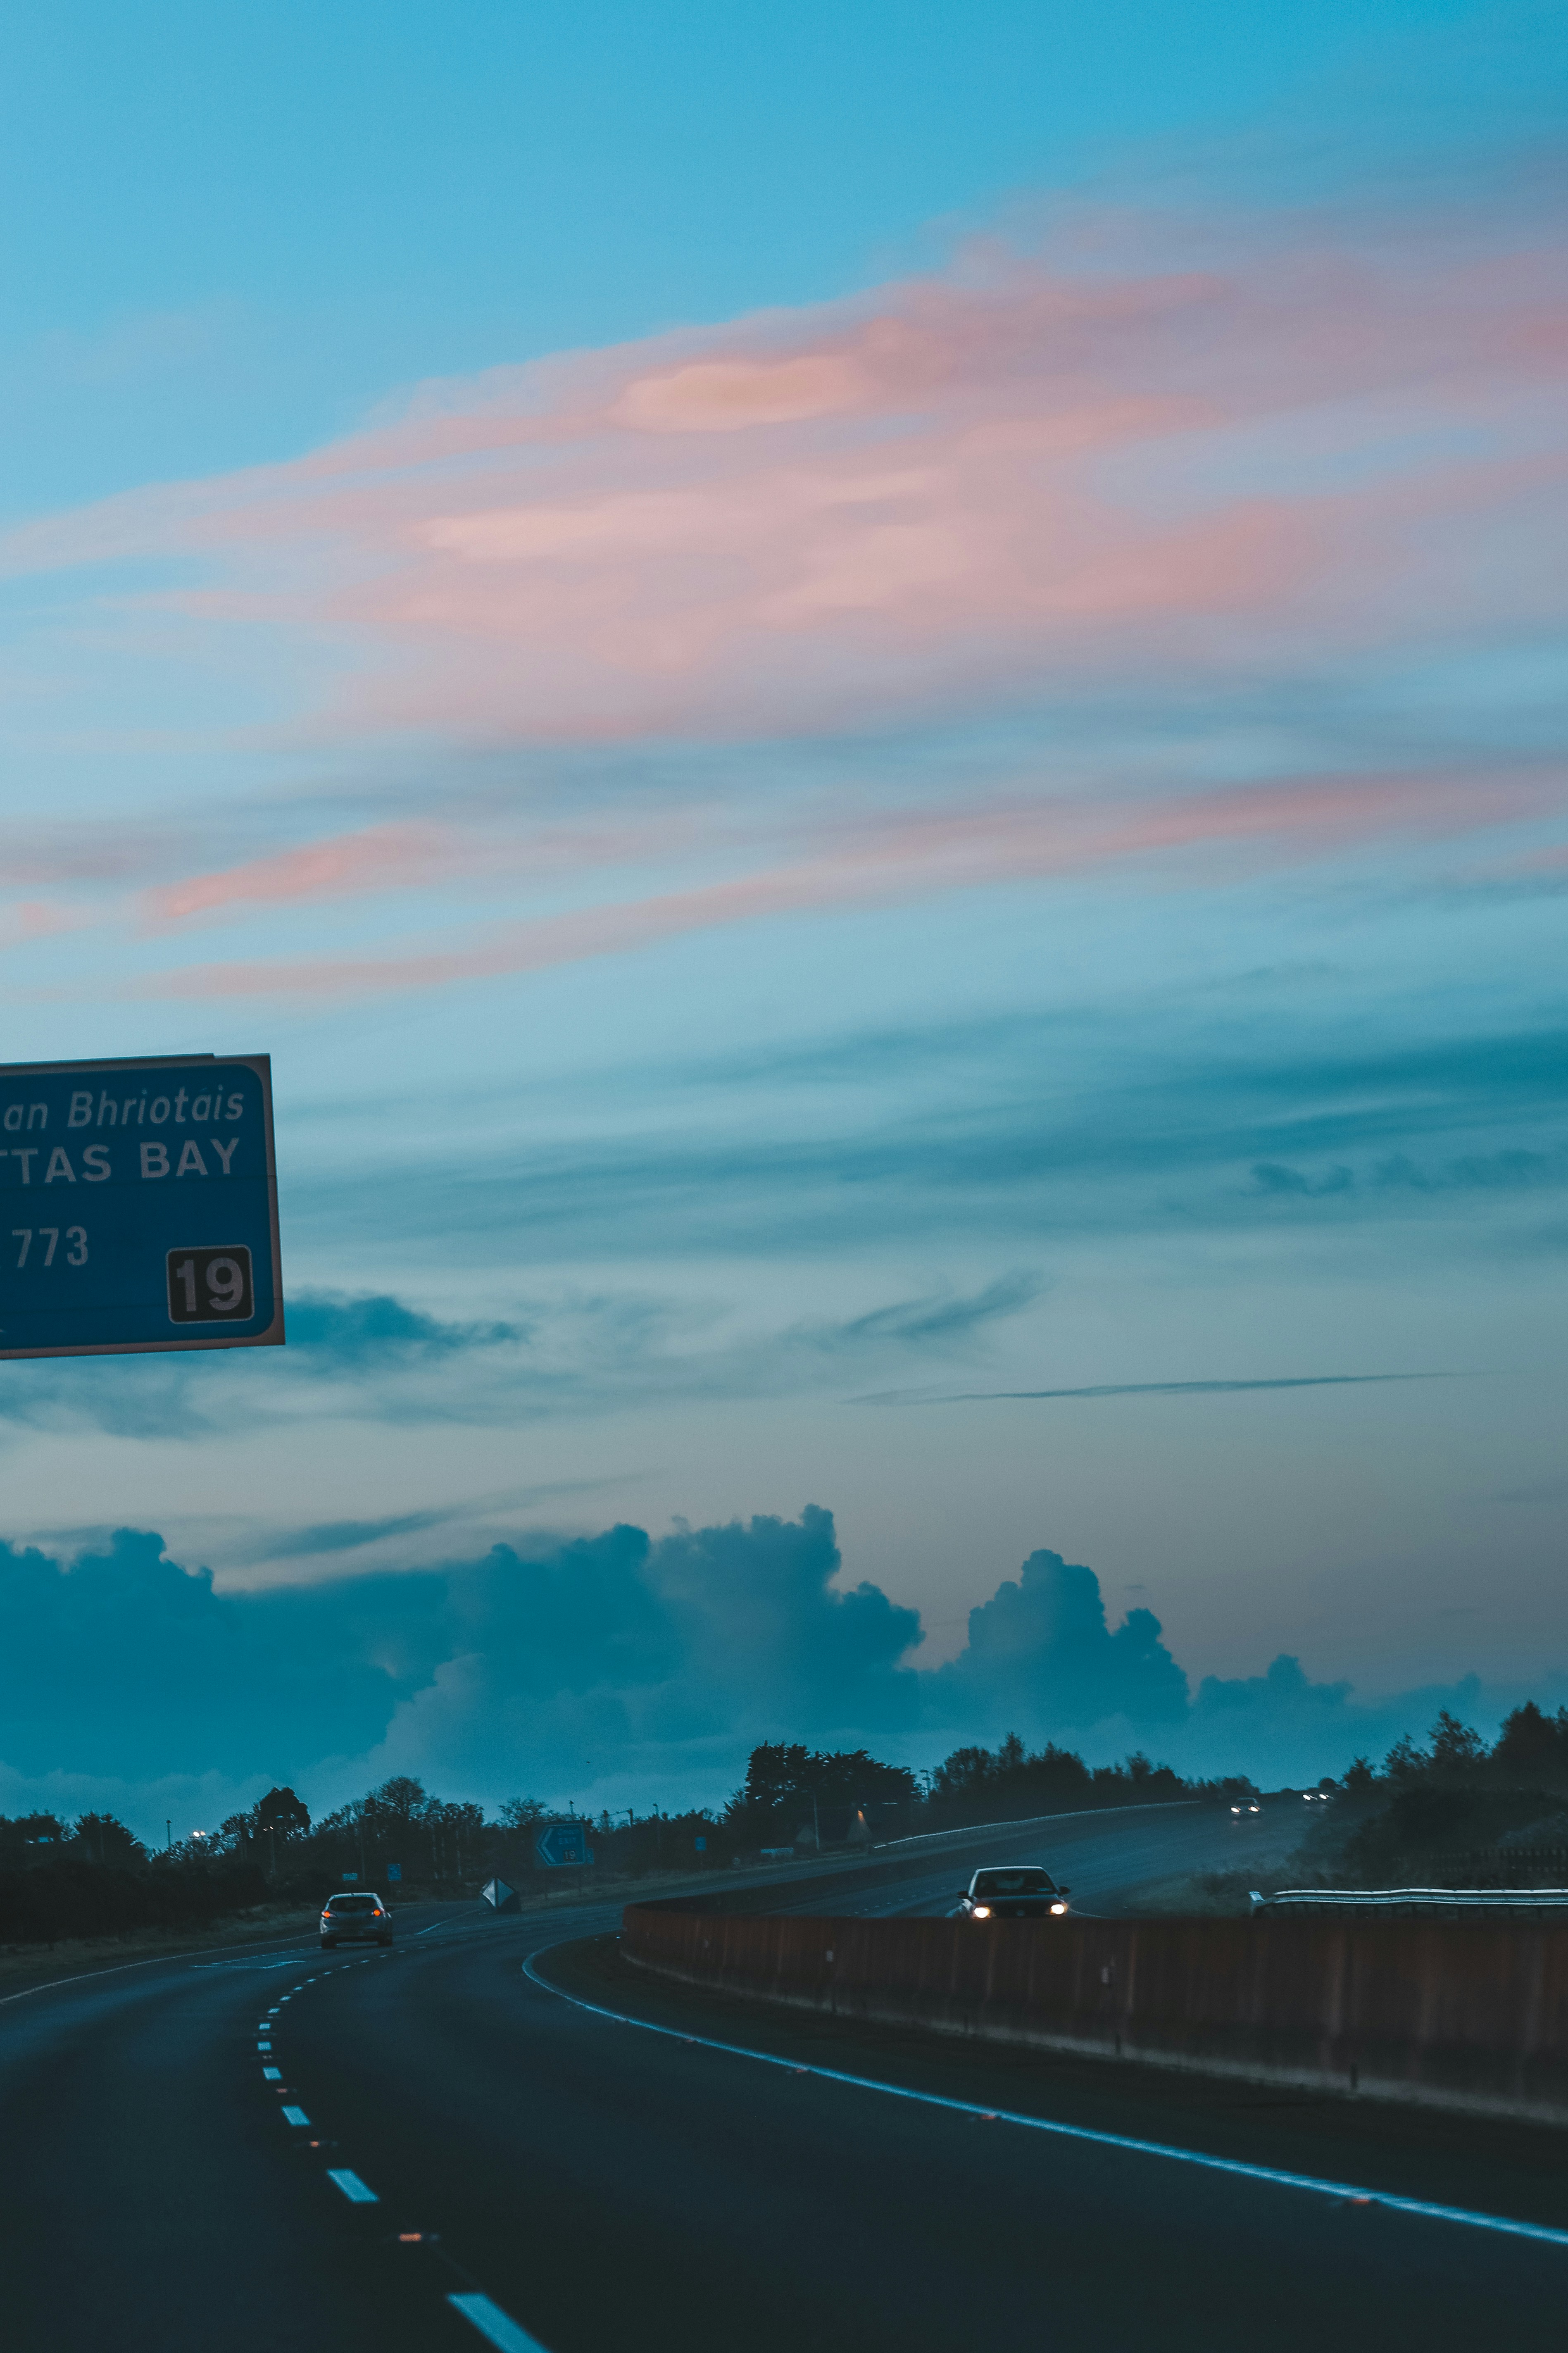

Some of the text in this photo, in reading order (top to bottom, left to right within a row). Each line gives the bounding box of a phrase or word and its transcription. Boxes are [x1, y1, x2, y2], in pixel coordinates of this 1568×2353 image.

[3, 1084, 244, 1131] an Bhriotáis
[0, 1137, 240, 1184] TAS BAY
[12, 1226, 88, 1268] 773
[176, 1257, 244, 1312] 19
[564, 1850, 575, 1859] 19
